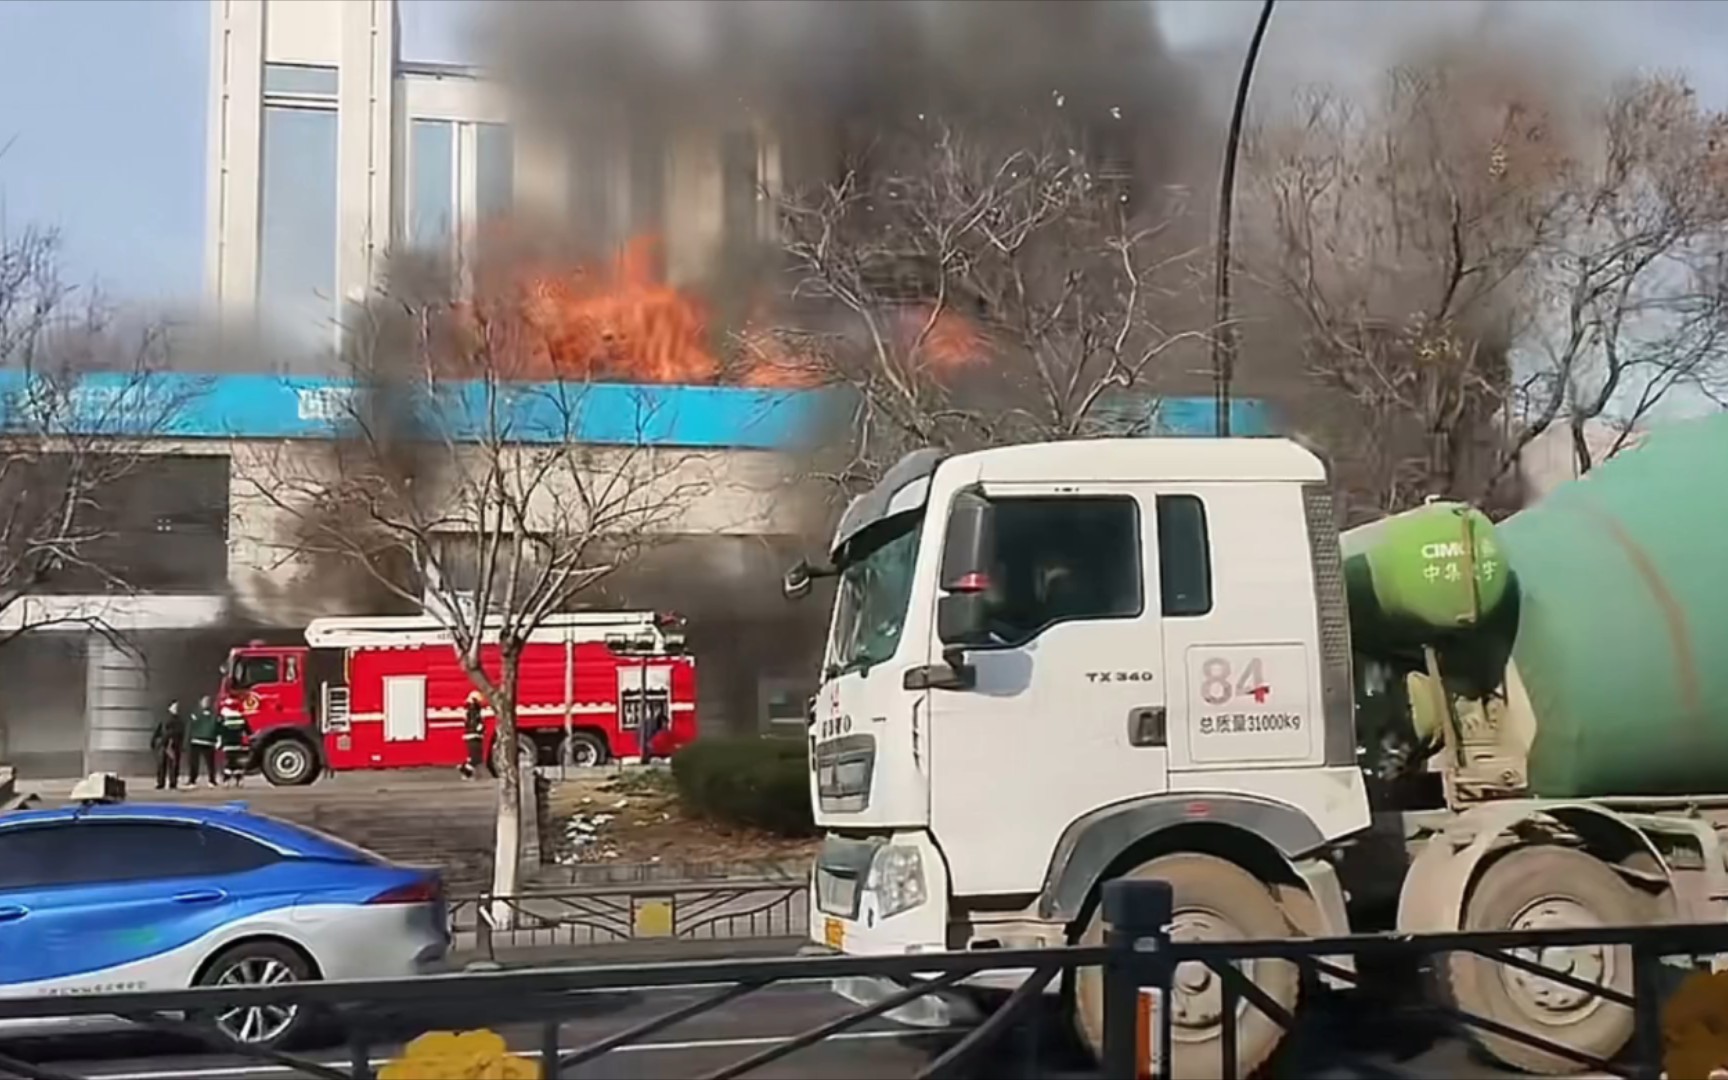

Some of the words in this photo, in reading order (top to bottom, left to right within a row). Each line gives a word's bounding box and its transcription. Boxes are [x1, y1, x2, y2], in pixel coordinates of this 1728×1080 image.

[1423, 560, 1498, 583] 中集宇
[1085, 672, 1113, 682] TX
[1116, 672, 1153, 682] 340
[1201, 658, 1270, 703] 84
[1200, 714, 1300, 734] 总质量31000kg
